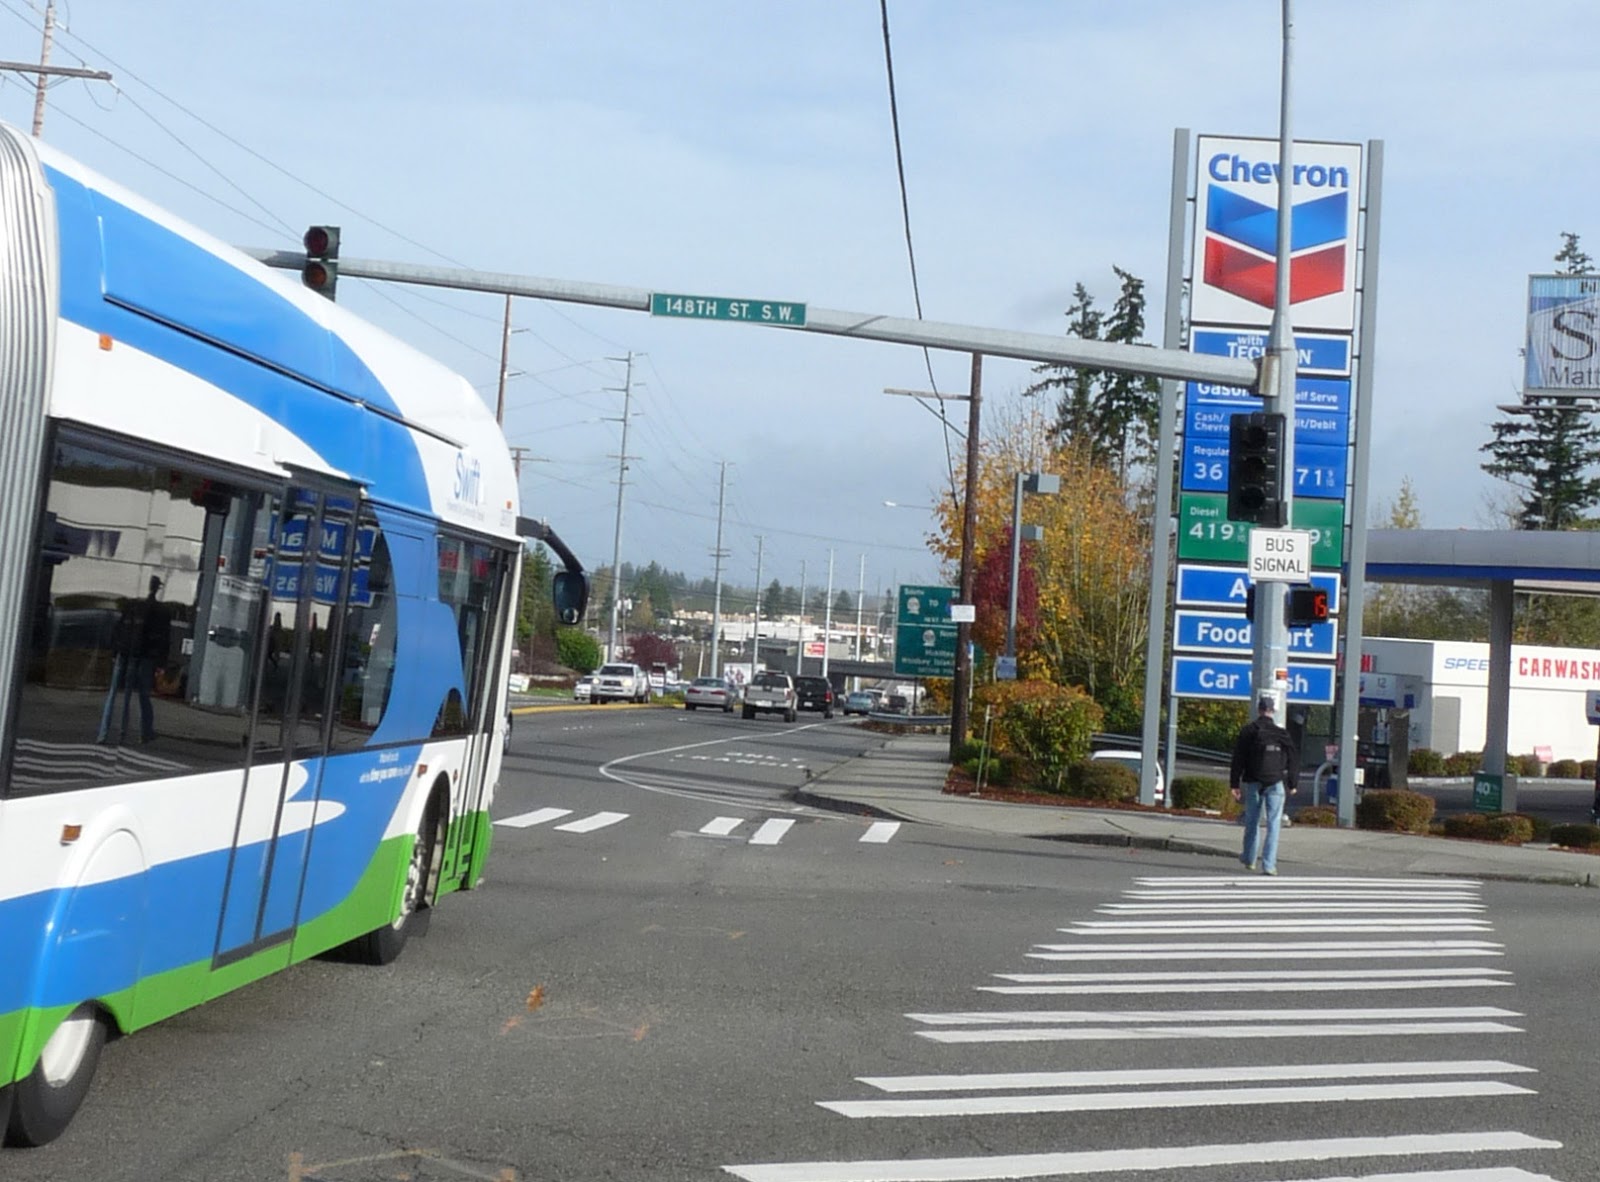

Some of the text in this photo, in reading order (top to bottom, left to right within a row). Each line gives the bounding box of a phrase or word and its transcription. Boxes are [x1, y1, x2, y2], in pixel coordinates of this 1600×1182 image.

[666, 298, 717, 315] 148TH
[729, 302, 751, 318] ST.
[1237, 335, 1264, 346] with
[1227, 342, 1312, 365] TECN
[1296, 392, 1338, 403] elf Serve
[1195, 412, 1225, 423] Cash/
[1195, 422, 1229, 432] Chevro
[1194, 462, 1223, 480] 36
[1296, 468, 1321, 485] 71
[1190, 506, 1219, 516] Diesel
[1189, 522, 1234, 540] 419
[1265, 538, 1294, 552] BUS
[1253, 557, 1305, 573] SIGNAL
[1229, 578, 1248, 598] A
[1197, 622, 1314, 647] Food rt
[1444, 657, 1600, 681] SPEE CARWASH
[1199, 669, 1240, 689] Car
